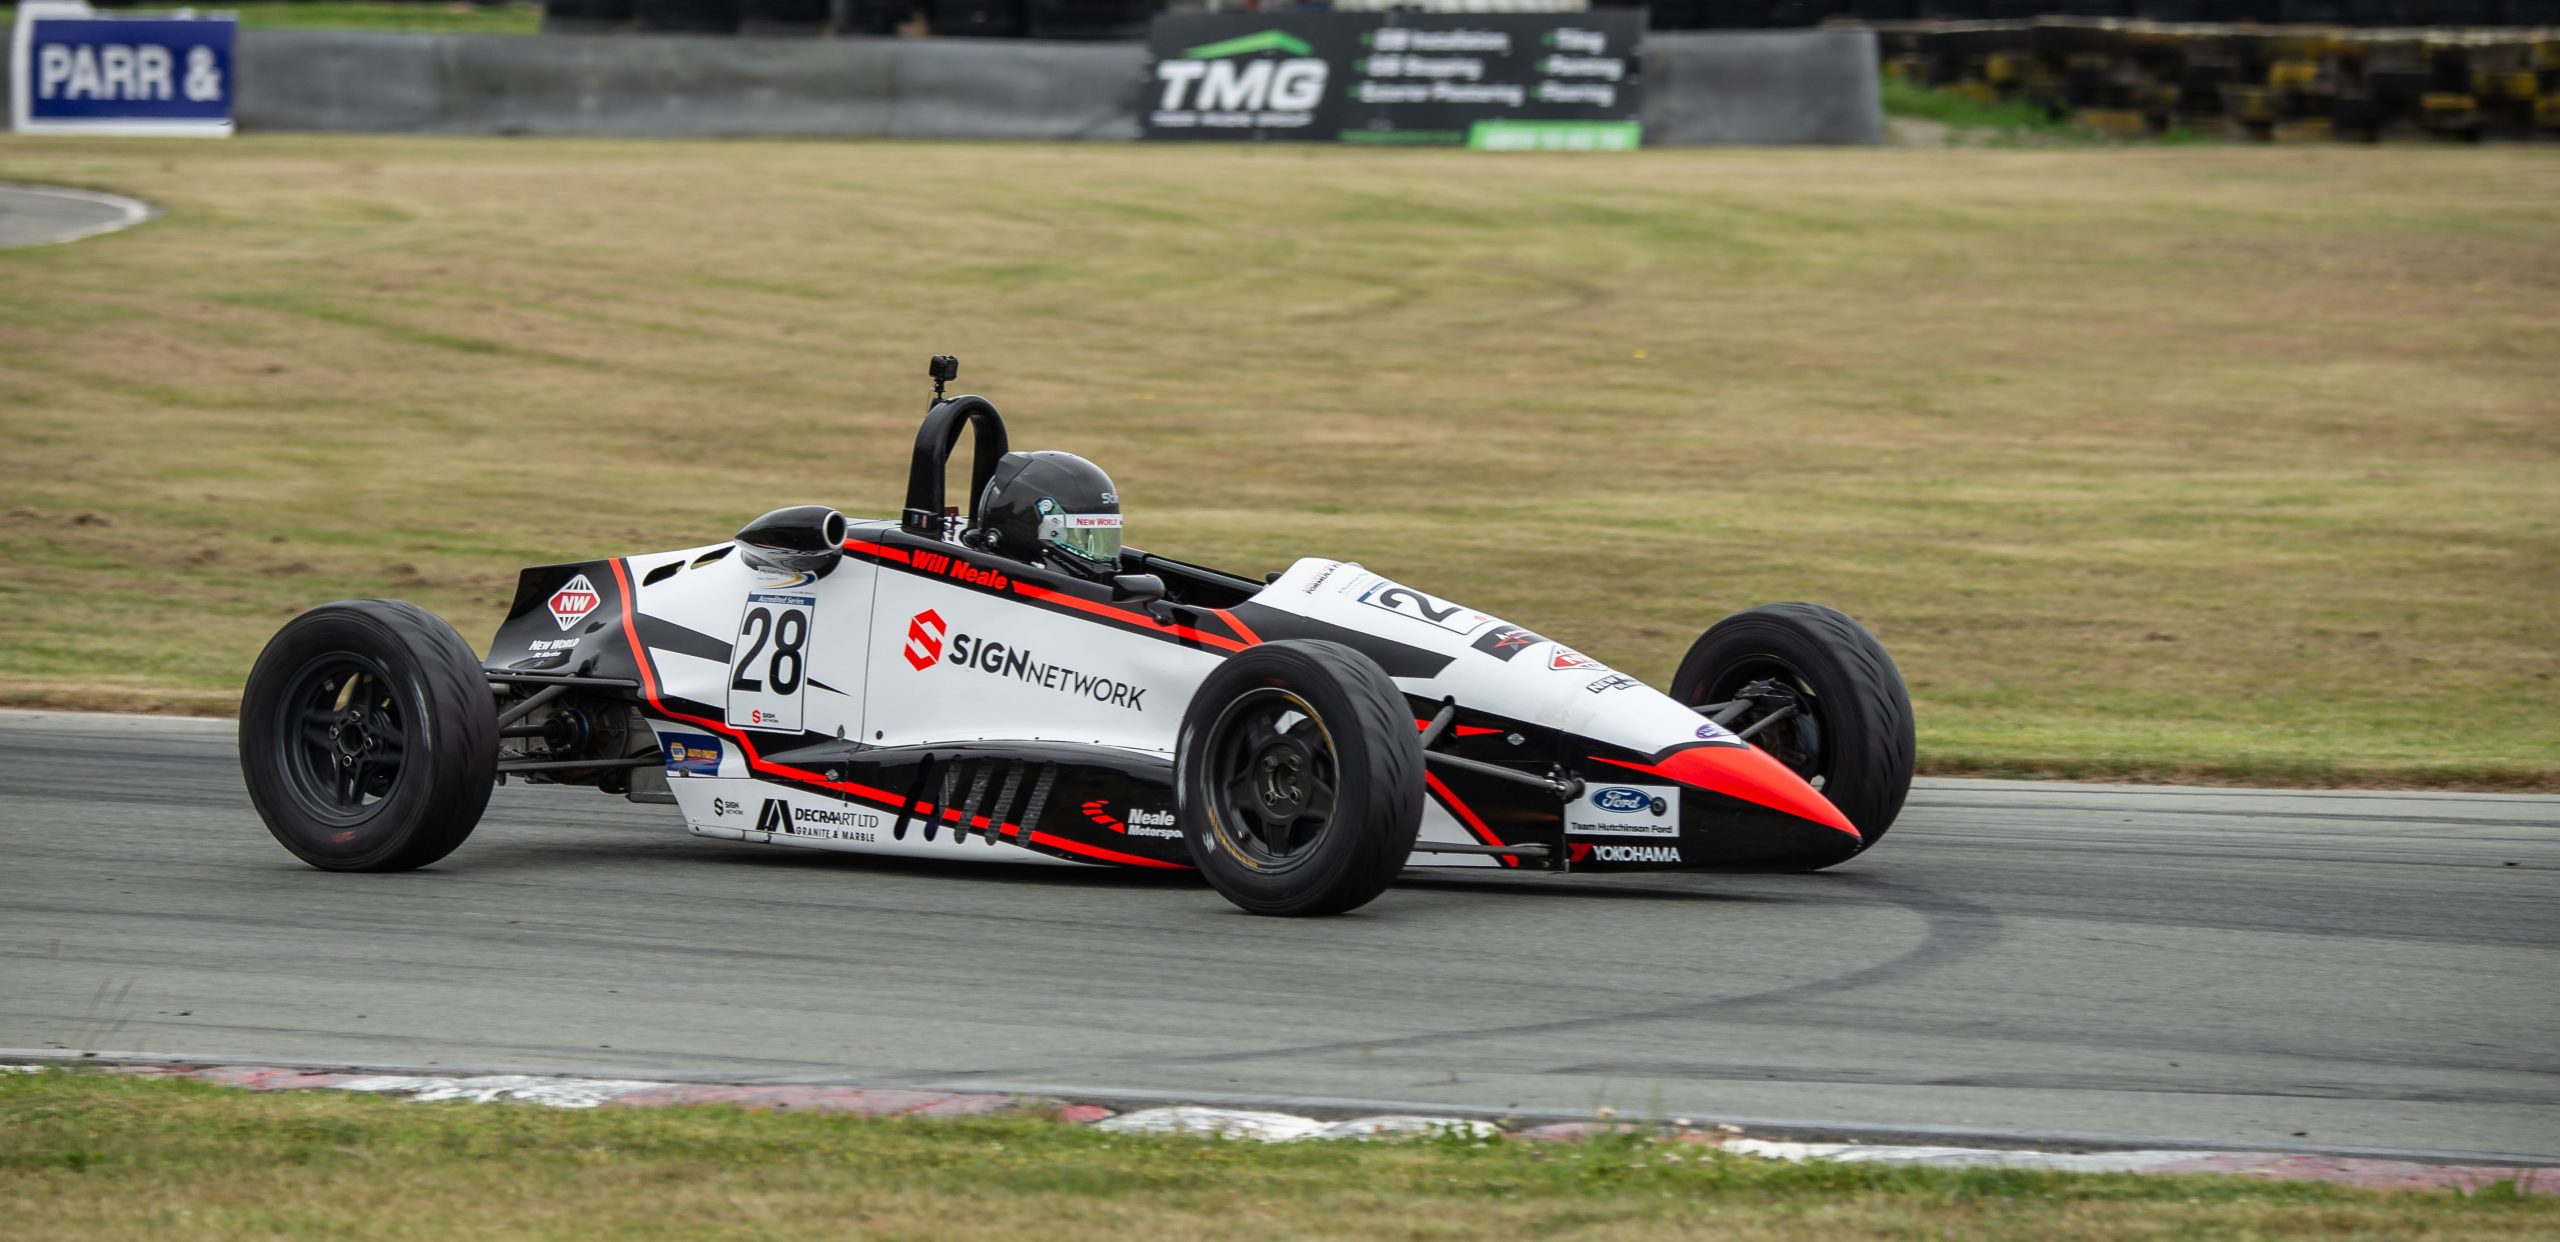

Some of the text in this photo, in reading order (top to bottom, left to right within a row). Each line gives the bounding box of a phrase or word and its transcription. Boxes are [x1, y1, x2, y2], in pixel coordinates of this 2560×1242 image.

[39, 43, 223, 103] PARR &
[1157, 58, 1330, 112] TMG
[912, 550, 1007, 590] Will Neale
[560, 596, 591, 611] NW
[529, 638, 580, 650] NEW WORLD
[732, 607, 807, 695] 28
[725, 801, 740, 809] SIGN
[1602, 791, 1640, 808] Ford
[857, 813, 879, 829] LTD
[1128, 808, 1176, 826] Neale
[795, 827, 831, 838] GRANITE
[841, 832, 876, 843] MARBLE
[1571, 822, 1673, 834] Team Hutchinson Ford
[1593, 846, 1681, 861] YOKOHAMA
